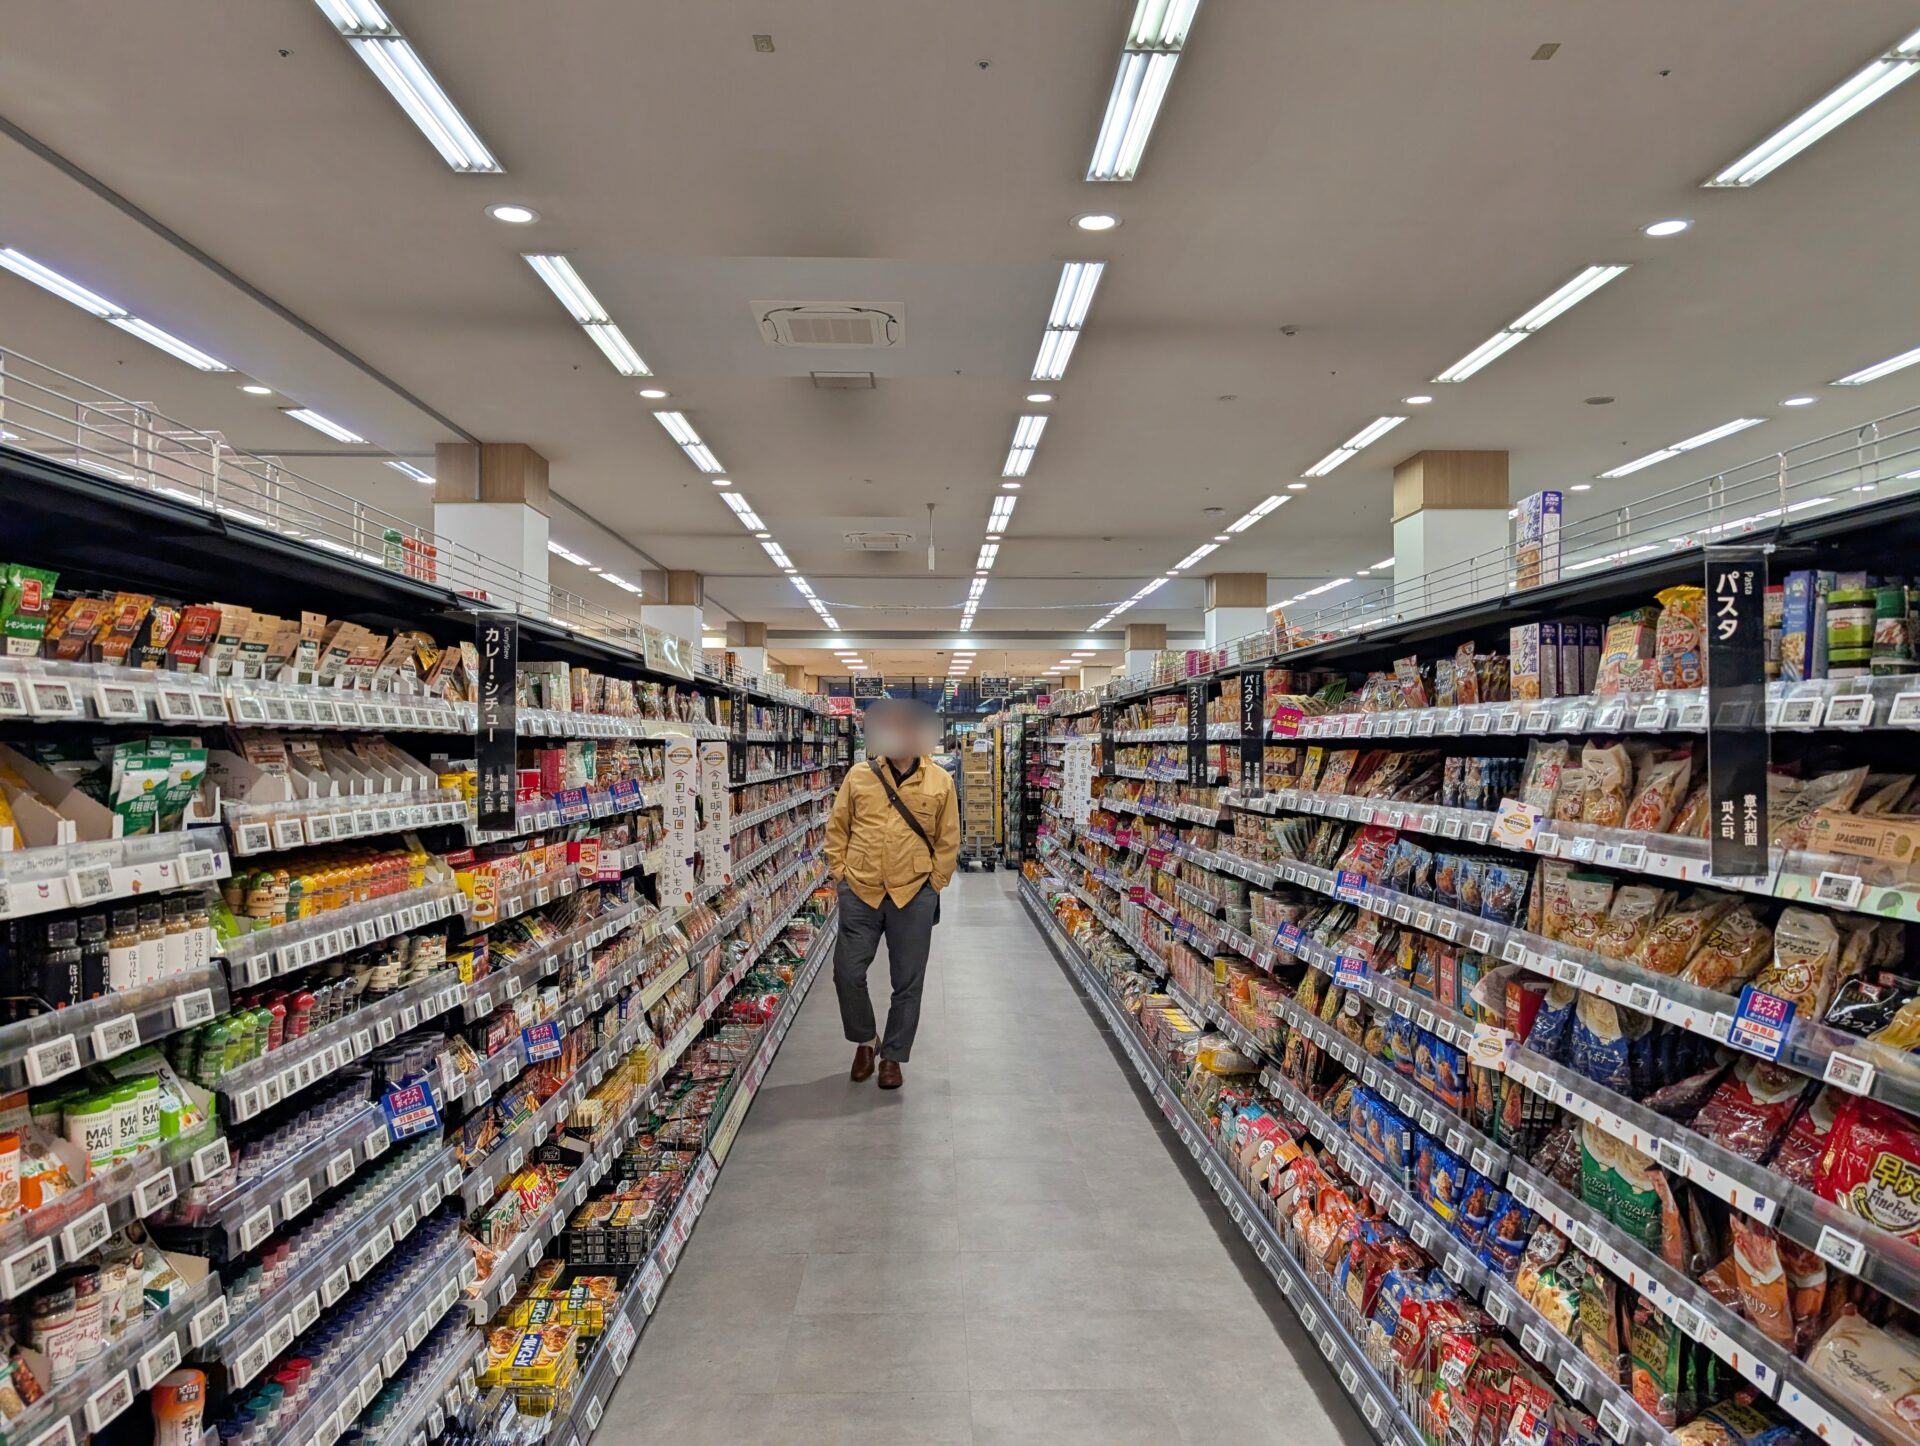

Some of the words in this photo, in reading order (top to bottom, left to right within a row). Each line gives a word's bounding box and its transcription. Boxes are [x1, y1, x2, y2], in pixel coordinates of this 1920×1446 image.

[1744, 570, 1754, 595] Pasta
[1715, 571, 1739, 640] パスタ
[1522, 625, 1530, 674] グラタン
[1528, 625, 1537, 673] 北海道
[484, 627, 500, 743] カレー・シチュー
[1190, 686, 1199, 741] スナックスープ
[1244, 674, 1254, 731] パスタソース
[1720, 801, 1735, 840] 파스타
[1743, 794, 1758, 846] 意大利面
[1834, 832, 1876, 848] SPAGHETTI
[194, 931, 203, 968] ほりにし
[1752, 1003, 1779, 1018] ポイント
[1755, 995, 1782, 1009] ボーナス
[118, 1030, 132, 1042] 920
[532, 1031, 550, 1040] ポイント
[1743, 1021, 1776, 1039] 対象商品
[394, 1088, 418, 1102] ボーナス
[396, 1096, 420, 1108] ポイント
[89, 1224, 103, 1237] 128
[30, 1257, 47, 1273] 448
[1833, 1348, 1896, 1394] Spaghetti
